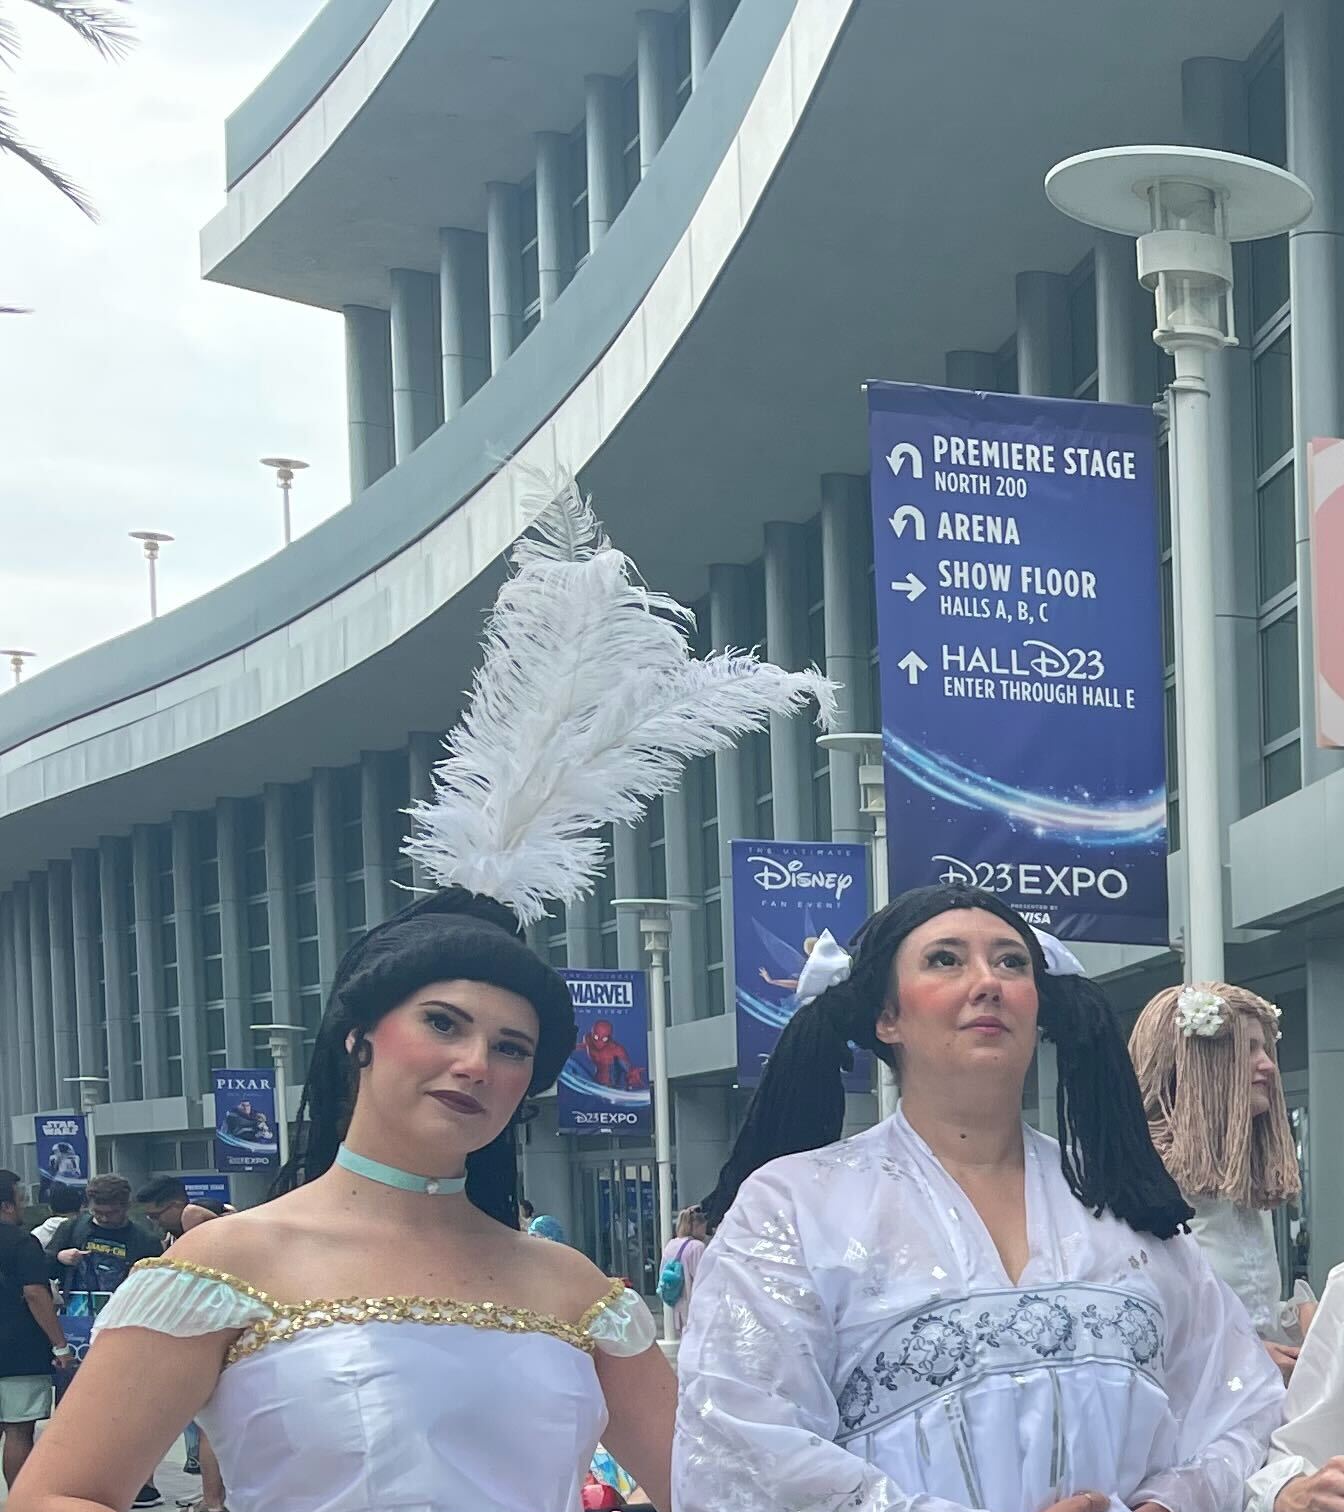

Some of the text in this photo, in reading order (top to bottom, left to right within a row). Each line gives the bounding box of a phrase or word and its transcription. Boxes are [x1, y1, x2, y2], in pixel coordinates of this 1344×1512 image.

[933, 435, 1136, 480] PREMIERE STAGE
[934, 471, 1027, 498] NORTH 200
[937, 511, 1021, 545] ARENA
[938, 560, 1097, 599] SHOW FLOOR
[940, 595, 1049, 625] HALLS A, B, C
[942, 640, 1105, 681] HALL D23
[943, 676, 1135, 709] ENTER THROUGH HALL E
[1018, 864, 1129, 899] EXPO
[761, 900, 787, 908] FAN
[1018, 911, 1051, 924] VISA
[569, 983, 630, 1004] MARVEL
[216, 1078, 271, 1090] PIXAR
[600, 1112, 638, 1124] EXPO
